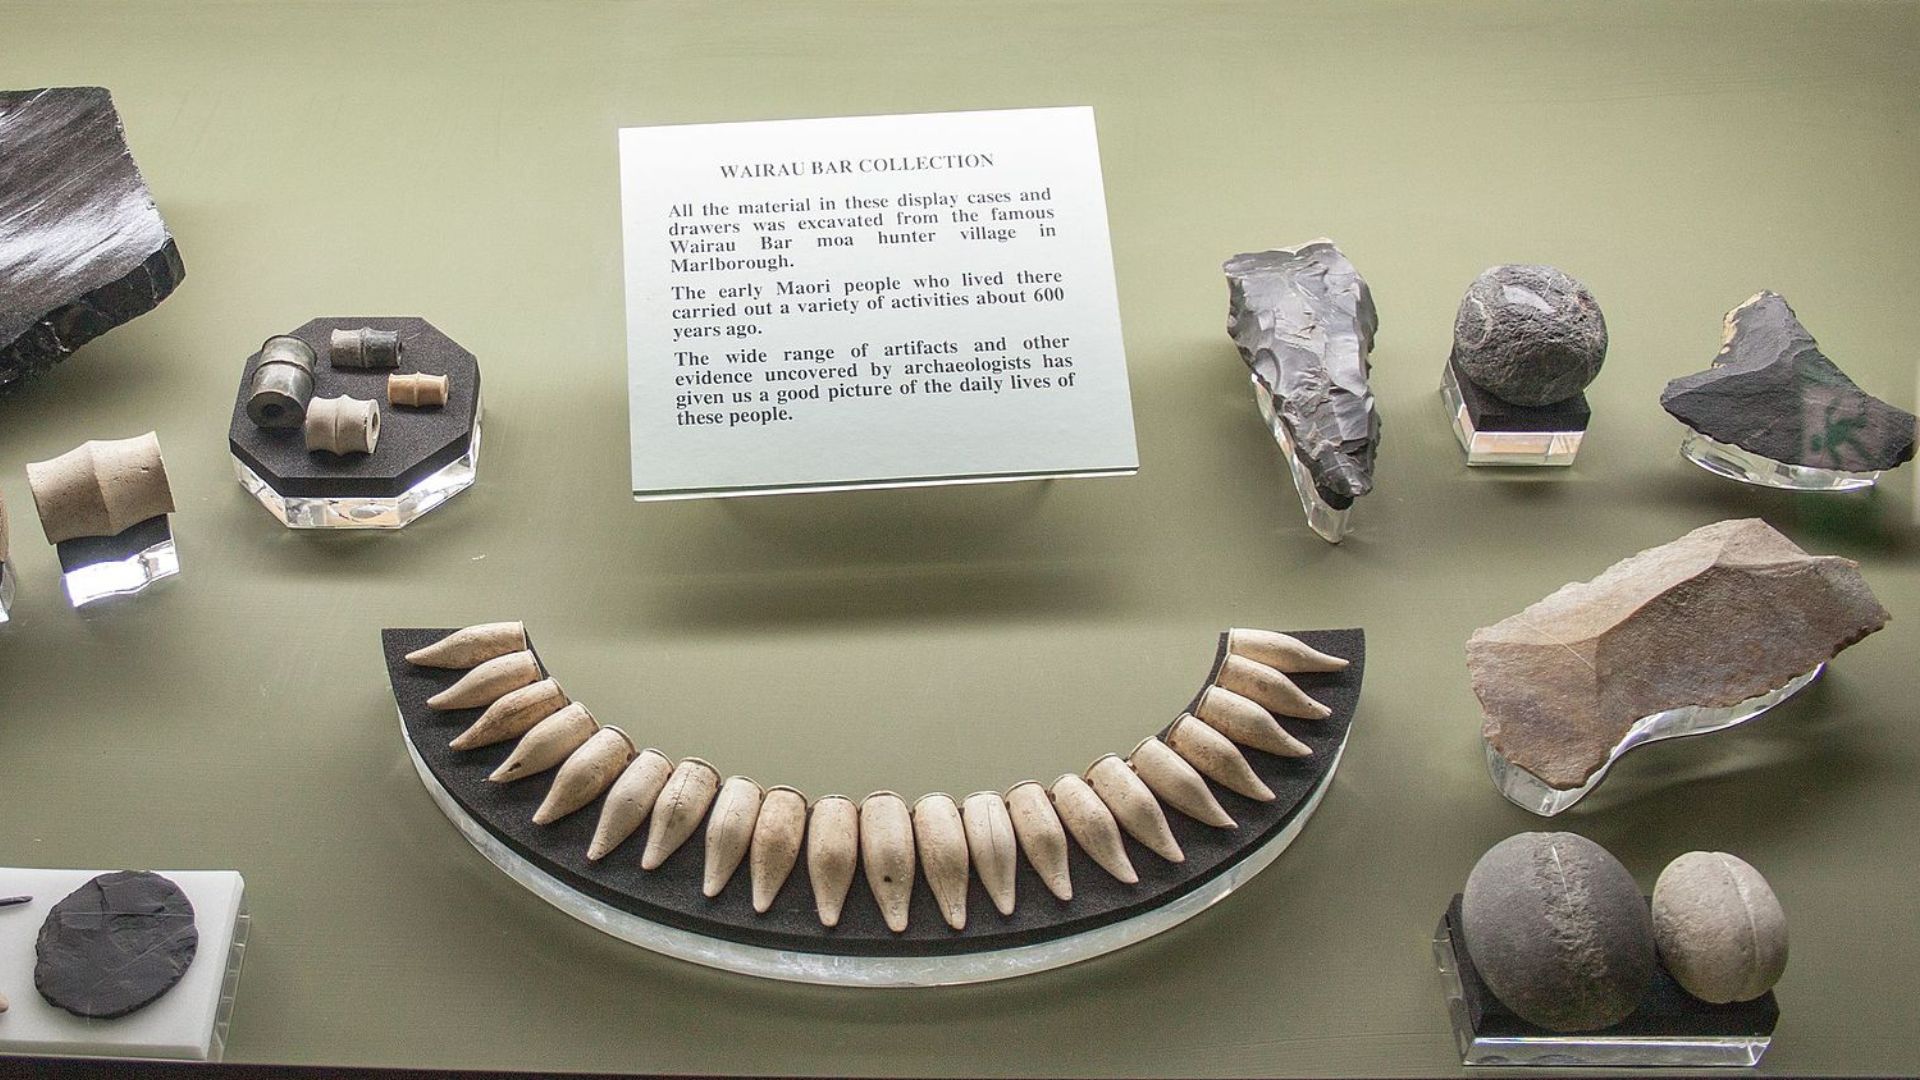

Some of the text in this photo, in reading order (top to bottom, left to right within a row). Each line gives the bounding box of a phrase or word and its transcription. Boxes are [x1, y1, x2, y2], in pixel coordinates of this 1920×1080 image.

[721, 154, 993, 178] WAIRAU BAR COLLECTION
[669, 187, 1051, 217] All the material in these display cases and
[669, 208, 1054, 236] drawers was excavated from the famous
[670, 224, 1056, 254] Wairau Bar moa hunter village in
[671, 254, 794, 273] Marlborough.
[671, 270, 1062, 300] The early Maori people who lived there
[672, 287, 1064, 319] carried out a variety of activities about 600
[673, 325, 762, 342] years ago.
[674, 335, 1069, 366] The wide range of artifacts and other
[675, 354, 1073, 386] evidence uncovered by archaeologists has
[676, 372, 1076, 410] given us a good picture of the daily lives of
[677, 406, 792, 427] these people.
